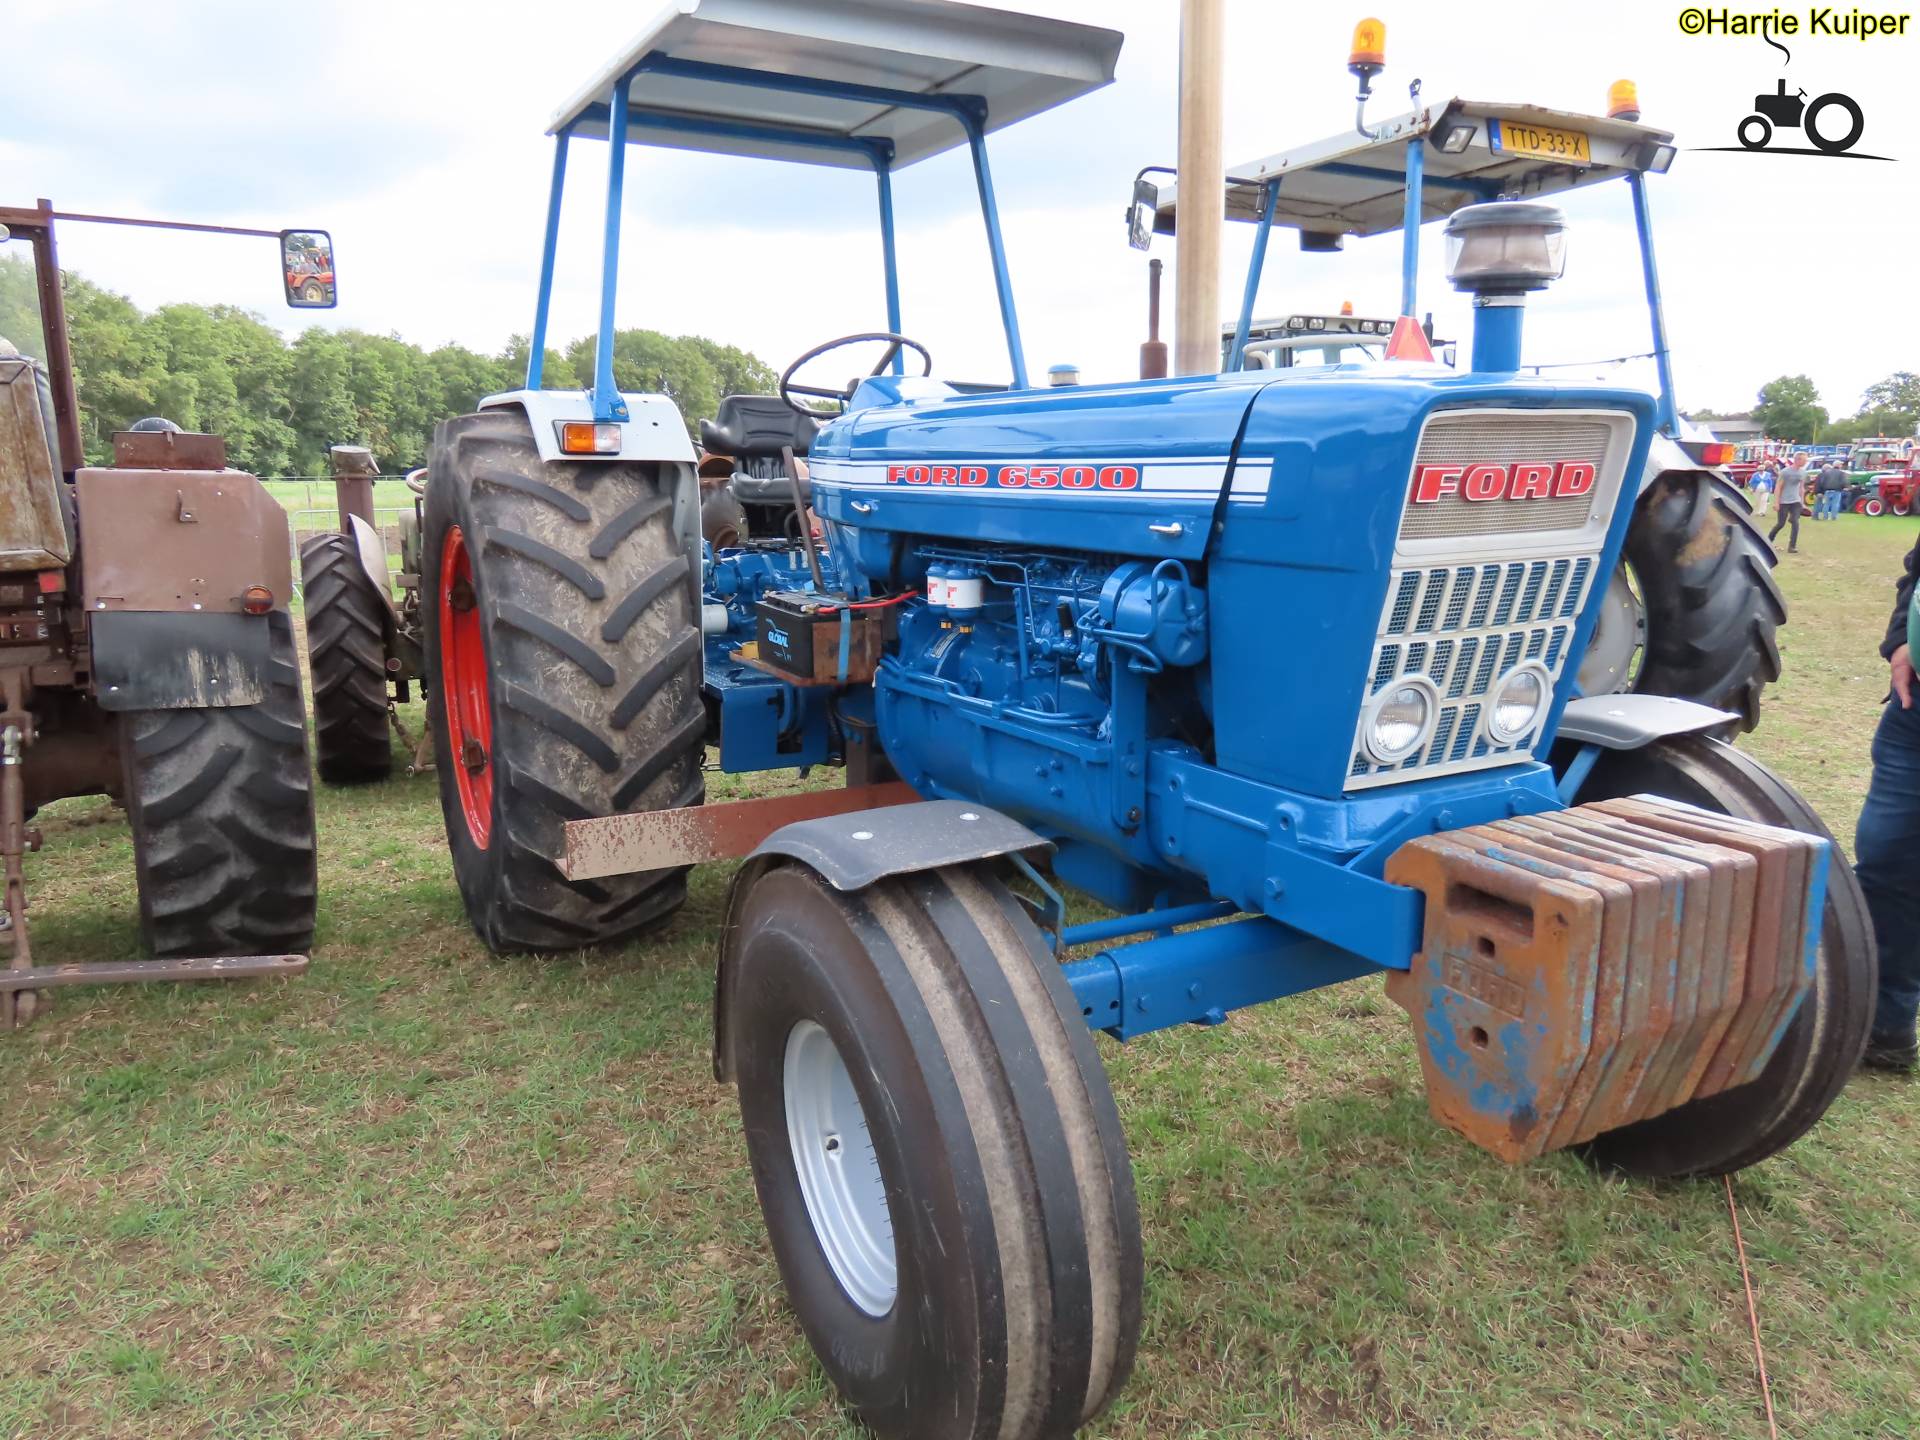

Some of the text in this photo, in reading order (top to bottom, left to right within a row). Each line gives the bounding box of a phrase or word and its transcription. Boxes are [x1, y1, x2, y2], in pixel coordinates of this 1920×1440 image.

[1507, 126, 1582, 157] TTD-33-X
[887, 465, 1139, 490] FORD 6500
[1411, 462, 1596, 504] FORD
